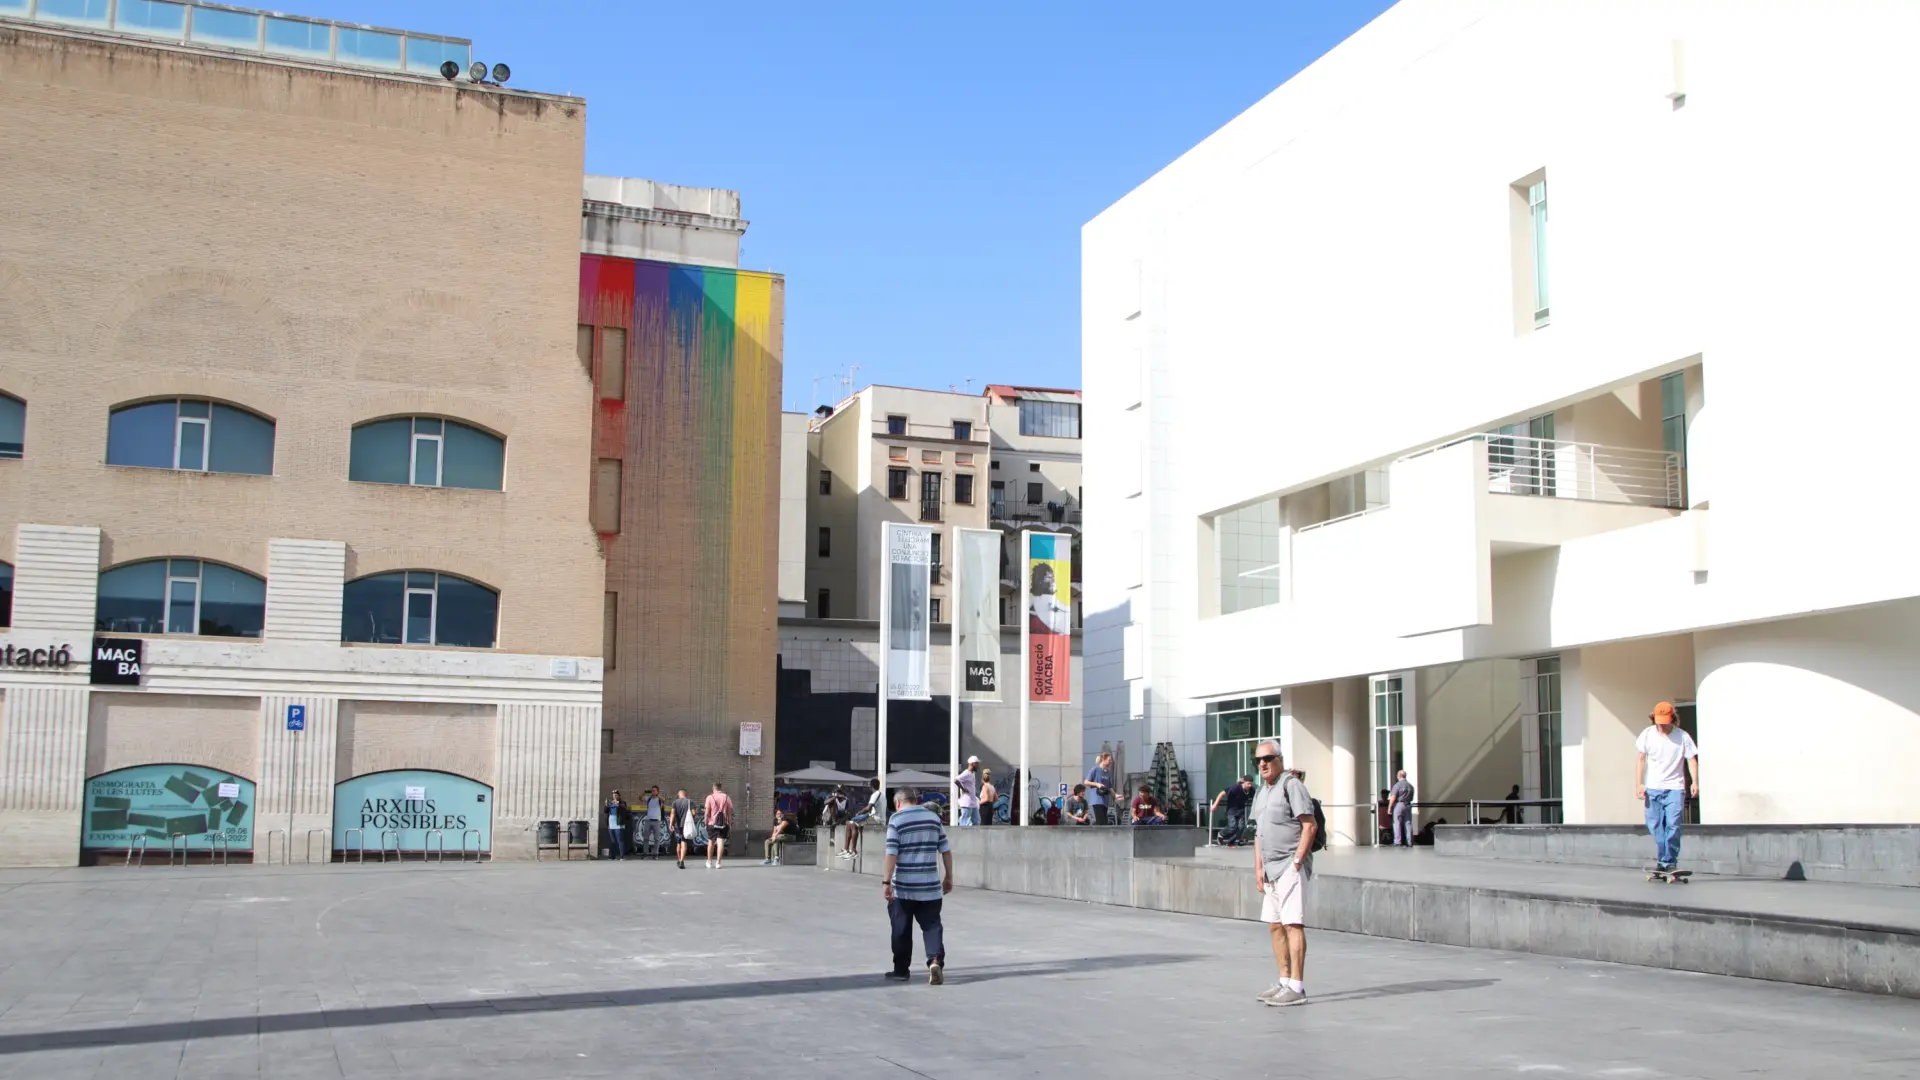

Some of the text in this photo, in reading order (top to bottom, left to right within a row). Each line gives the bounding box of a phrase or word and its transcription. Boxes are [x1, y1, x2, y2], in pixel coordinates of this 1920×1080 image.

[0, 643, 71, 668] tació
[97, 648, 136, 661] MAC
[118, 662, 141, 675] BA
[970, 667, 992, 676] MAC
[1045, 655, 1053, 695] MACBA
[982, 676, 995, 685] BA
[292, 708, 301, 719] P
[360, 798, 436, 813] ARXIUS
[360, 813, 467, 829] POSSIBLES
